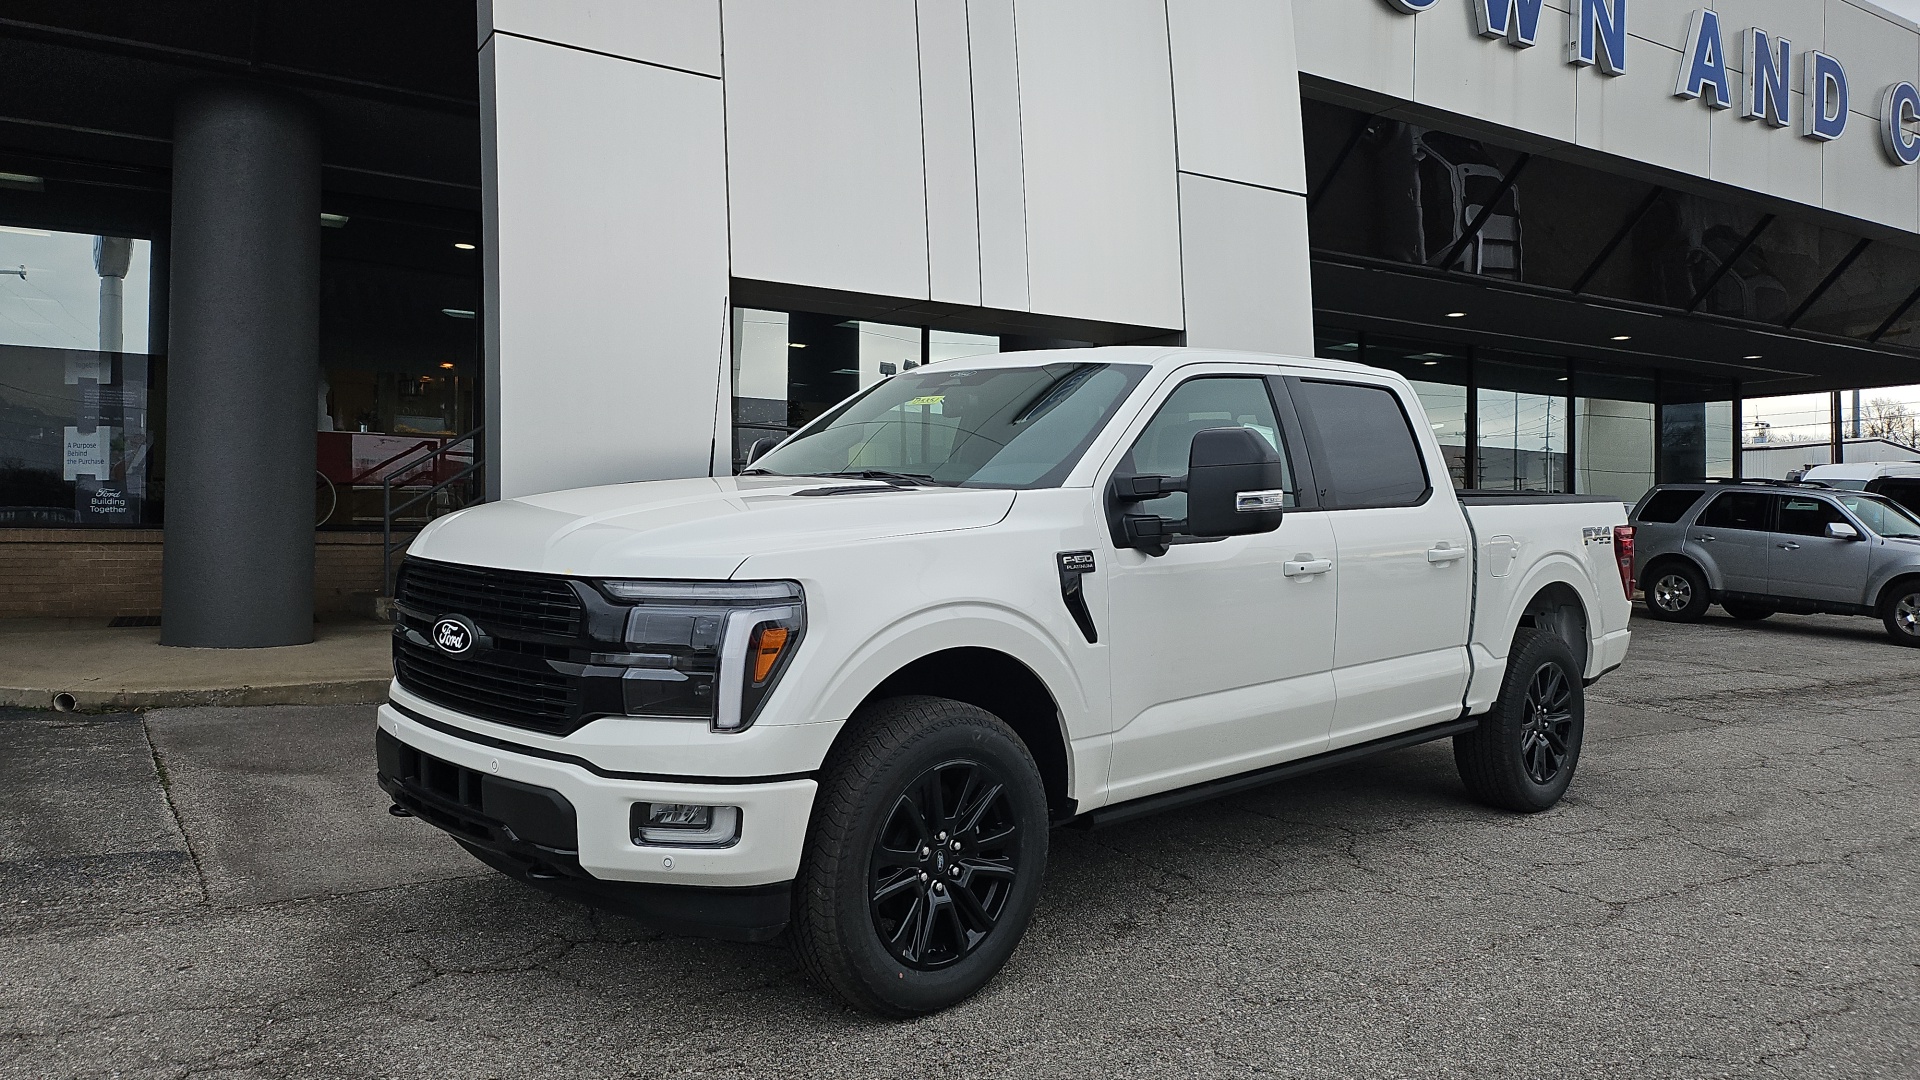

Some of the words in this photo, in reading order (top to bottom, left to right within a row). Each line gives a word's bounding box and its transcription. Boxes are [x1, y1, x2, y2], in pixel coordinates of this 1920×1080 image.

[1675, 8, 1850, 142] AND
[73, 442, 97, 450] Purpose
[95, 488, 122, 497] Ford
[91, 497, 126, 507] Building
[89, 505, 127, 514] Together
[1063, 555, 1093, 564] F-150
[439, 623, 464, 649] Ford
